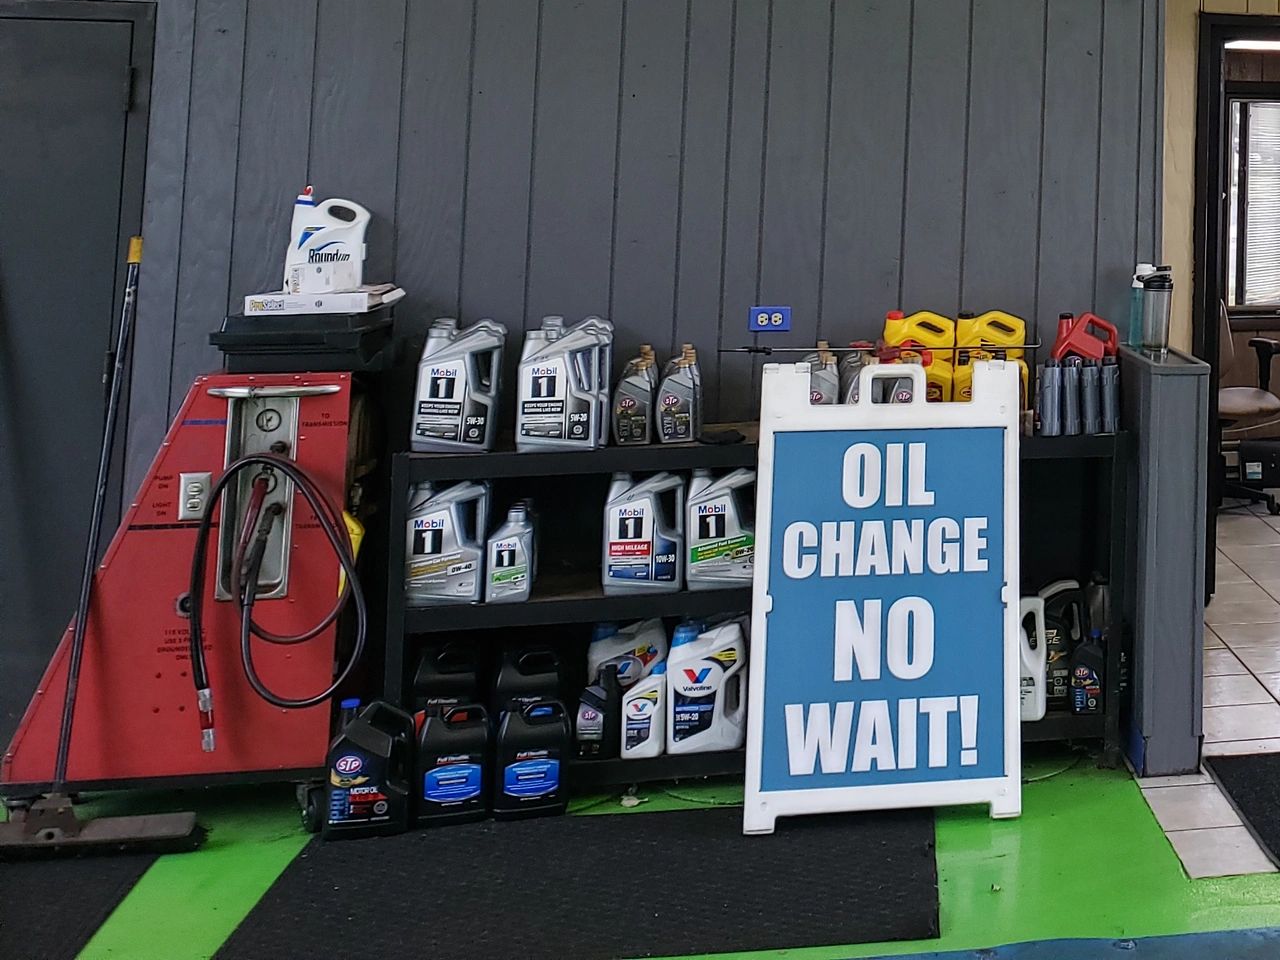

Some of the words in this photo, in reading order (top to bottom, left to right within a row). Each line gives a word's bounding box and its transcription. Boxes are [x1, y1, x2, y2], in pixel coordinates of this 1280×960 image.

[431, 368, 457, 376] Mobil
[531, 367, 557, 375] Mobil
[437, 379, 446, 398] 1
[538, 377, 548, 397] 1
[665, 396, 677, 405] STP
[898, 392, 910, 400] STP
[621, 399, 634, 407] STP
[842, 442, 935, 509] OIL
[619, 508, 644, 517] Mobil
[698, 504, 726, 514] Mobil
[414, 519, 444, 529] Mobil
[625, 519, 635, 538] 1
[706, 516, 716, 538] 1
[421, 530, 432, 554] 1
[782, 516, 989, 580] CHANGE
[501, 550, 509, 566] 1
[655, 554, 675, 563] 10W-30
[451, 563, 472, 573] 0W-40
[833, 595, 935, 683] NO
[784, 694, 980, 776] WAIT!
[338, 758, 360, 771] STP
[350, 787, 369, 795] MOTOR
[330, 790, 345, 820] PRO
